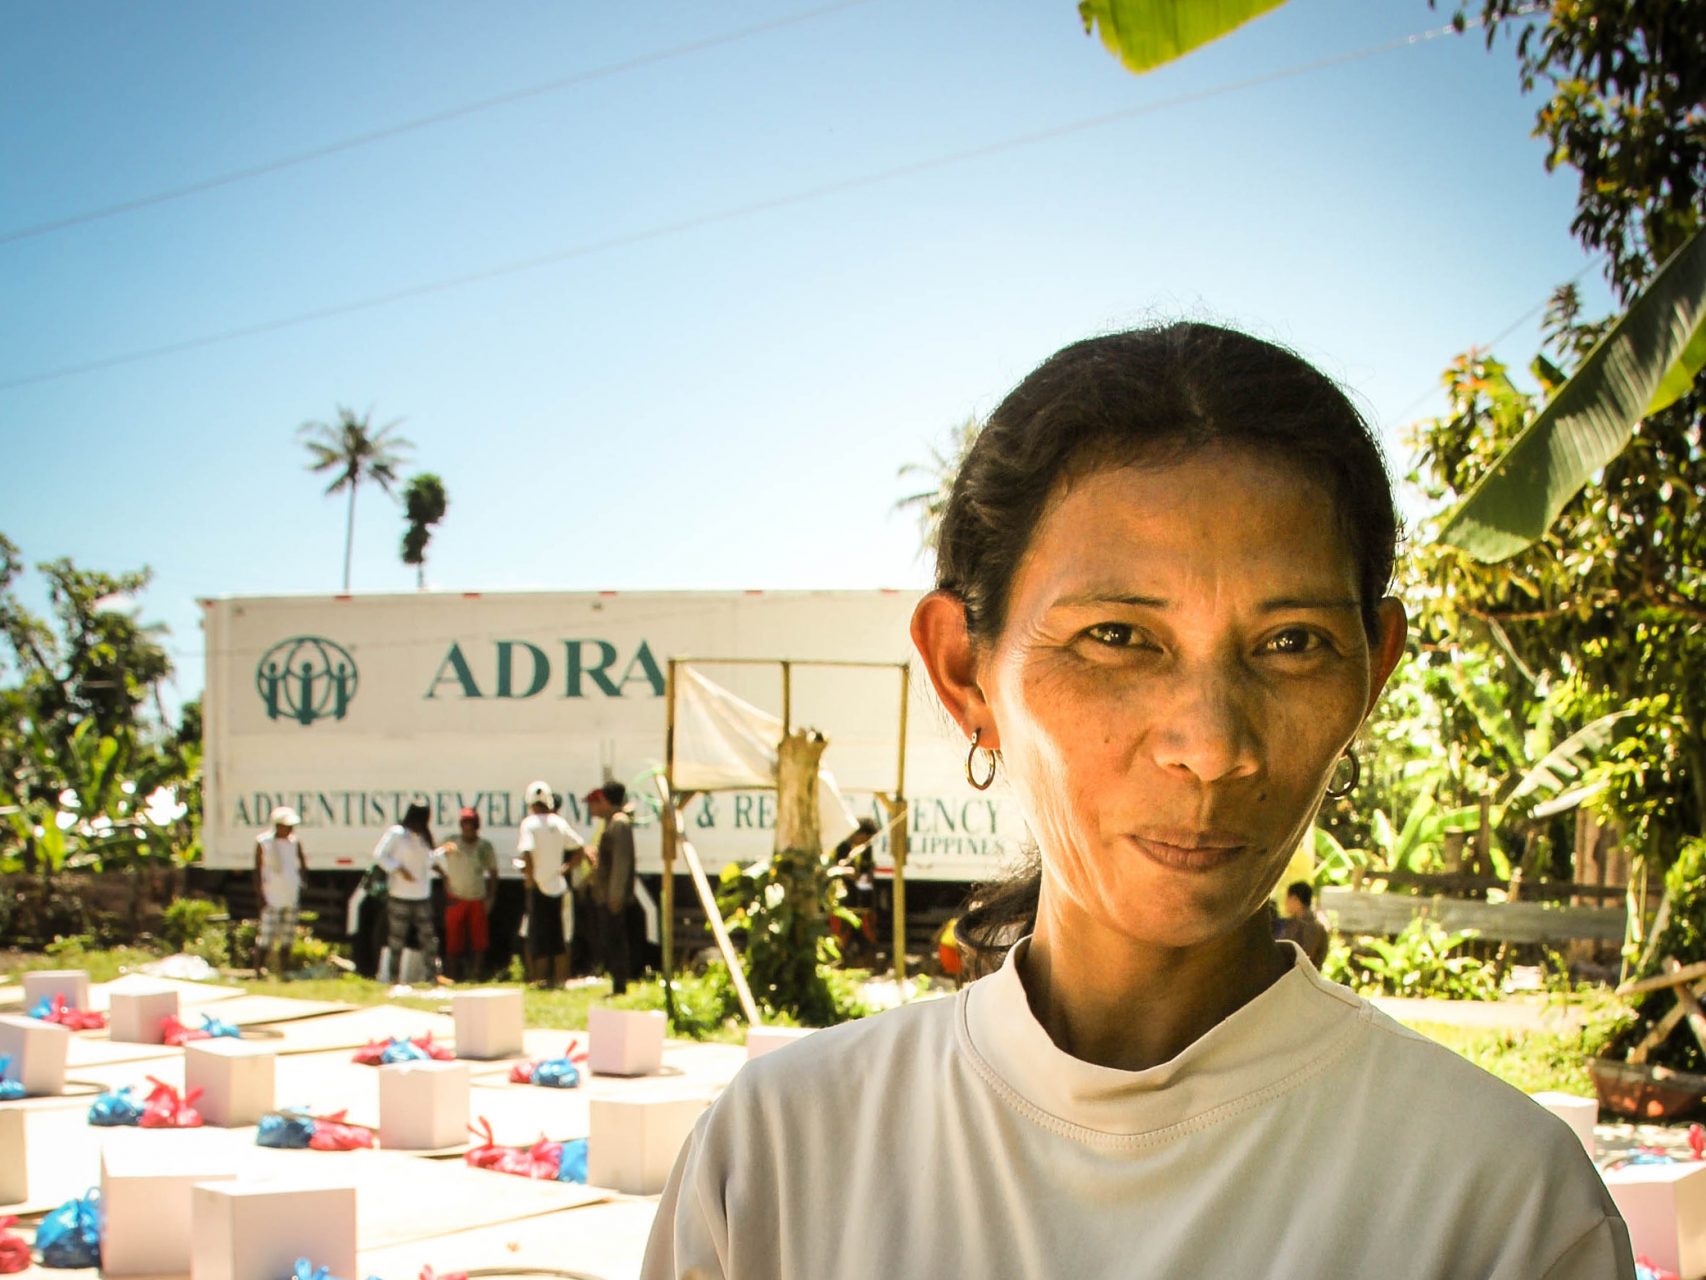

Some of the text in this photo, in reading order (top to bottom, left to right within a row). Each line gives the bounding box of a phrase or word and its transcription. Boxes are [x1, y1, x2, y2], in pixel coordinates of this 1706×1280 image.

[424, 639, 667, 698] ADRA
[696, 792, 718, 828] &
[866, 797, 1001, 833] AENCY
